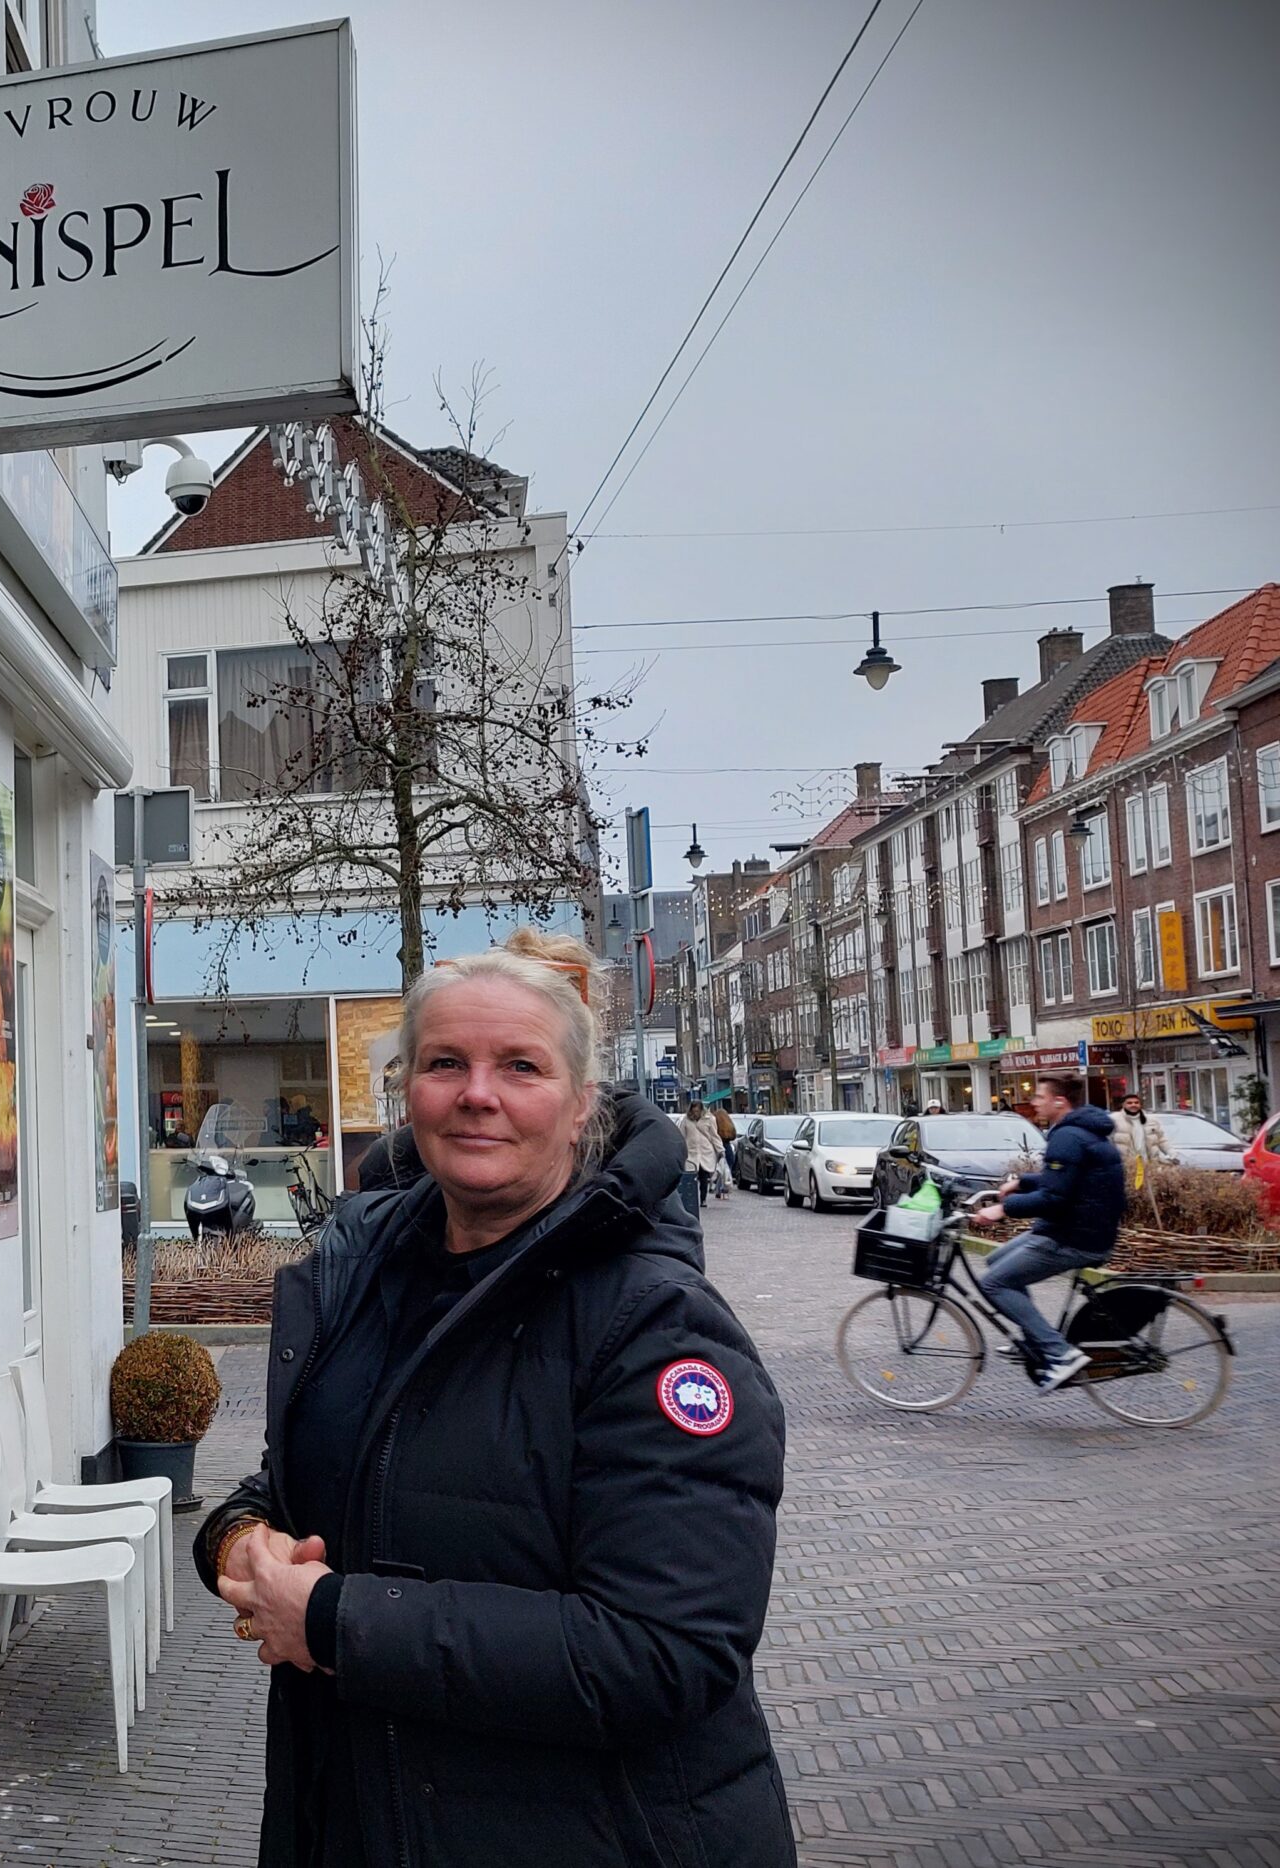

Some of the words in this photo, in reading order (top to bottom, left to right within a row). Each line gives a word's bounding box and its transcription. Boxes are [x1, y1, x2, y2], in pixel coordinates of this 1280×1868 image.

[1096, 1020, 1123, 1037] TOKO
[1156, 1012, 1176, 1031] TAN
[670, 1365, 699, 1379] CANADA
[670, 1406, 693, 1426] ARCTIC
[693, 1418, 724, 1430] PROGRAM
